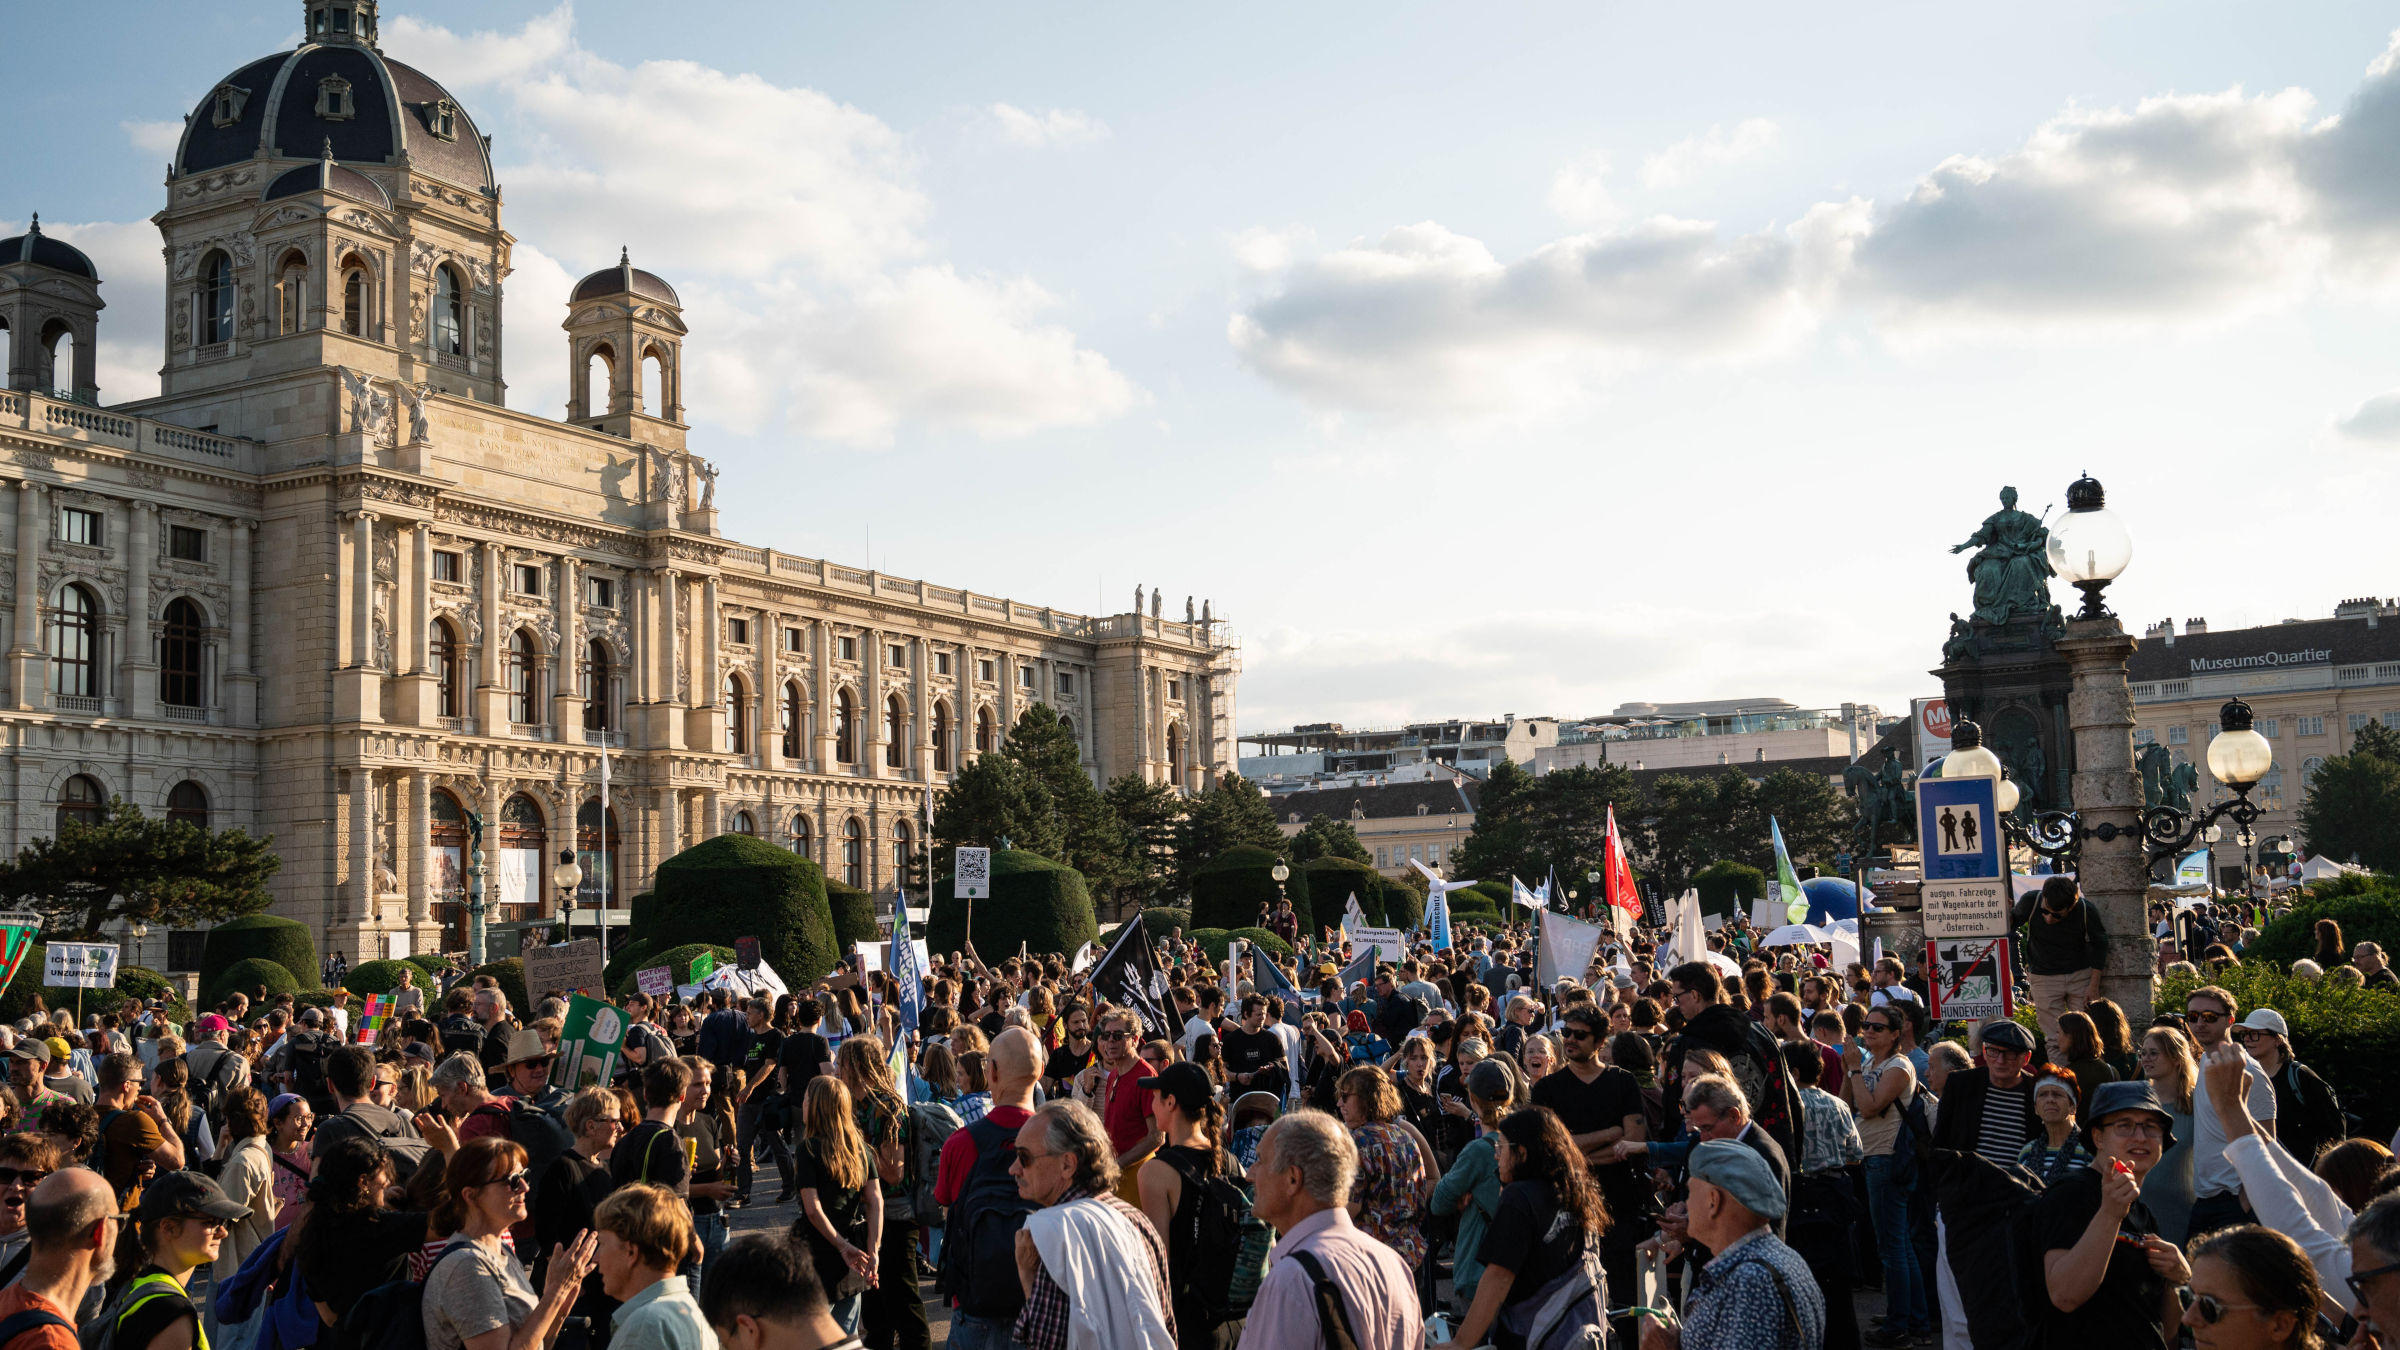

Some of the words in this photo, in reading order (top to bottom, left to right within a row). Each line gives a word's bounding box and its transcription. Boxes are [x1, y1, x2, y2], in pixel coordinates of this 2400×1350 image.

[2191, 648, 2332, 671] MuseumsQuartier
[1930, 889, 1957, 899] ausgen.
[1959, 888, 1996, 897] Fahrzeuge
[1620, 888, 1643, 914] nke
[1942, 901, 1985, 910] Wagenkarte
[1925, 911, 2003, 922] Burghauptmannschaft
[69, 957, 85, 965] BIN
[51, 970, 110, 978] UNZUFRIEDEN
[638, 970, 653, 978] NOT
[1122, 992, 1133, 1007] SEA
[1941, 1004, 2003, 1018] HUNDEVERBOT
